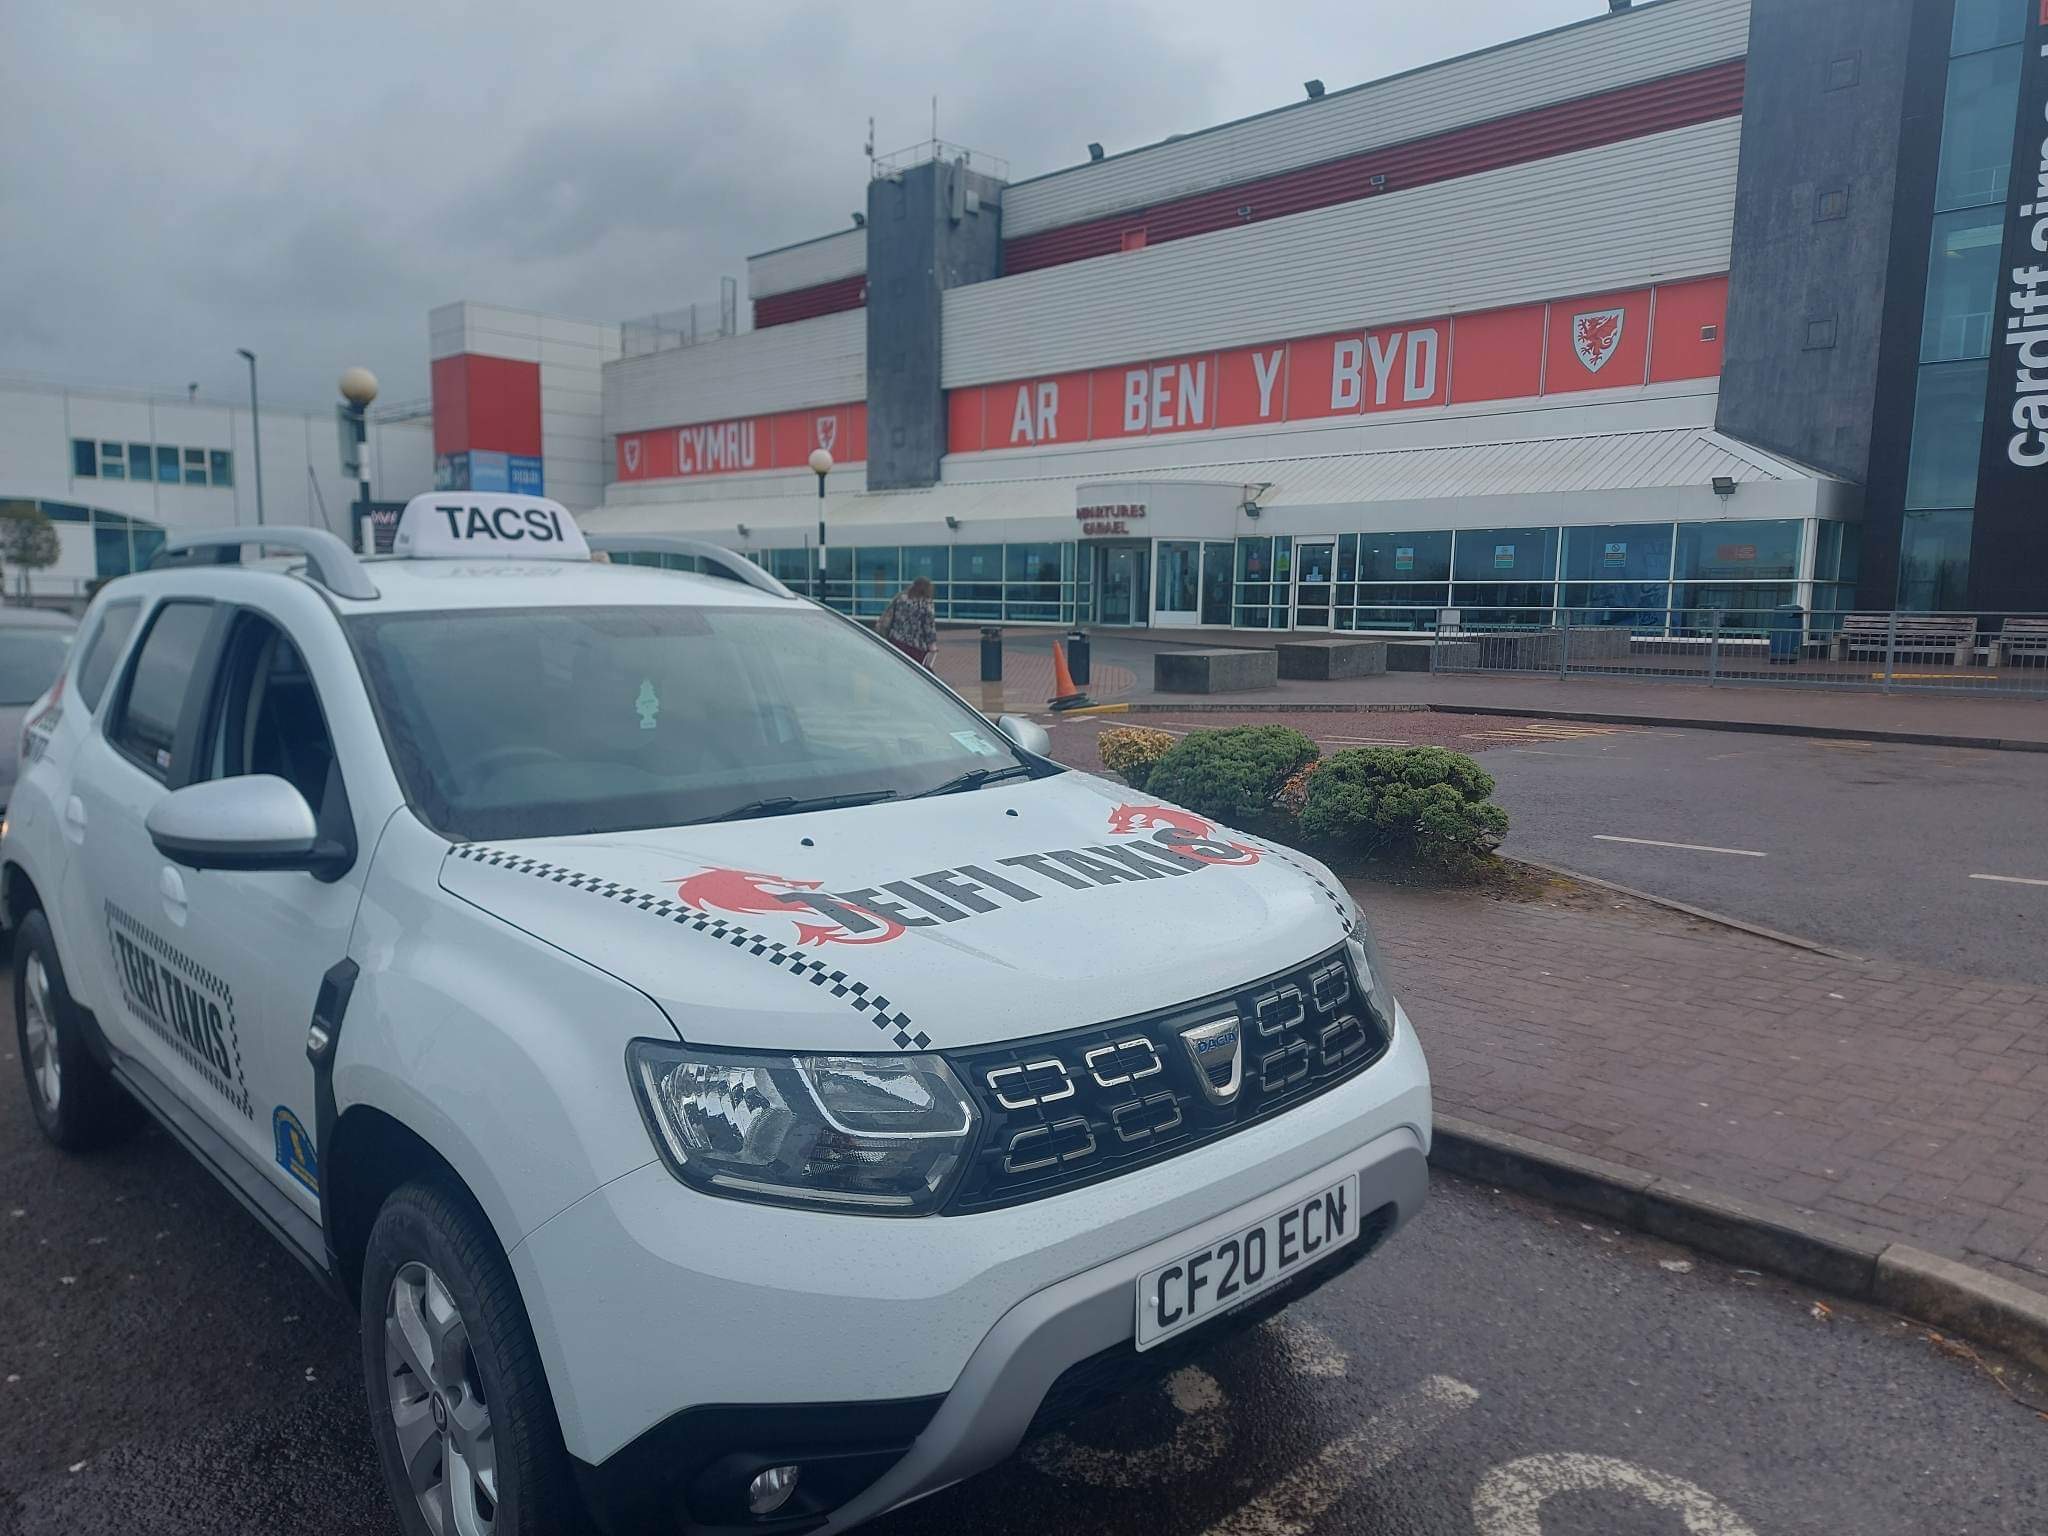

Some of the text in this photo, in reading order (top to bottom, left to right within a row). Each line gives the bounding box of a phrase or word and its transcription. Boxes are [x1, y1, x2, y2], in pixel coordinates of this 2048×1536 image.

[1010, 327, 1438, 442] AR BEN Y BYD
[678, 420, 756, 473] CYMRU
[435, 506, 564, 542] TACSI
[774, 827, 1245, 935] TEIFI TAXIS
[115, 929, 232, 1081] TEIFI TAXIS
[1198, 1031, 1237, 1053] DACIA
[1157, 1227, 1266, 1328] CF20
[1278, 1186, 1346, 1270] ECN
